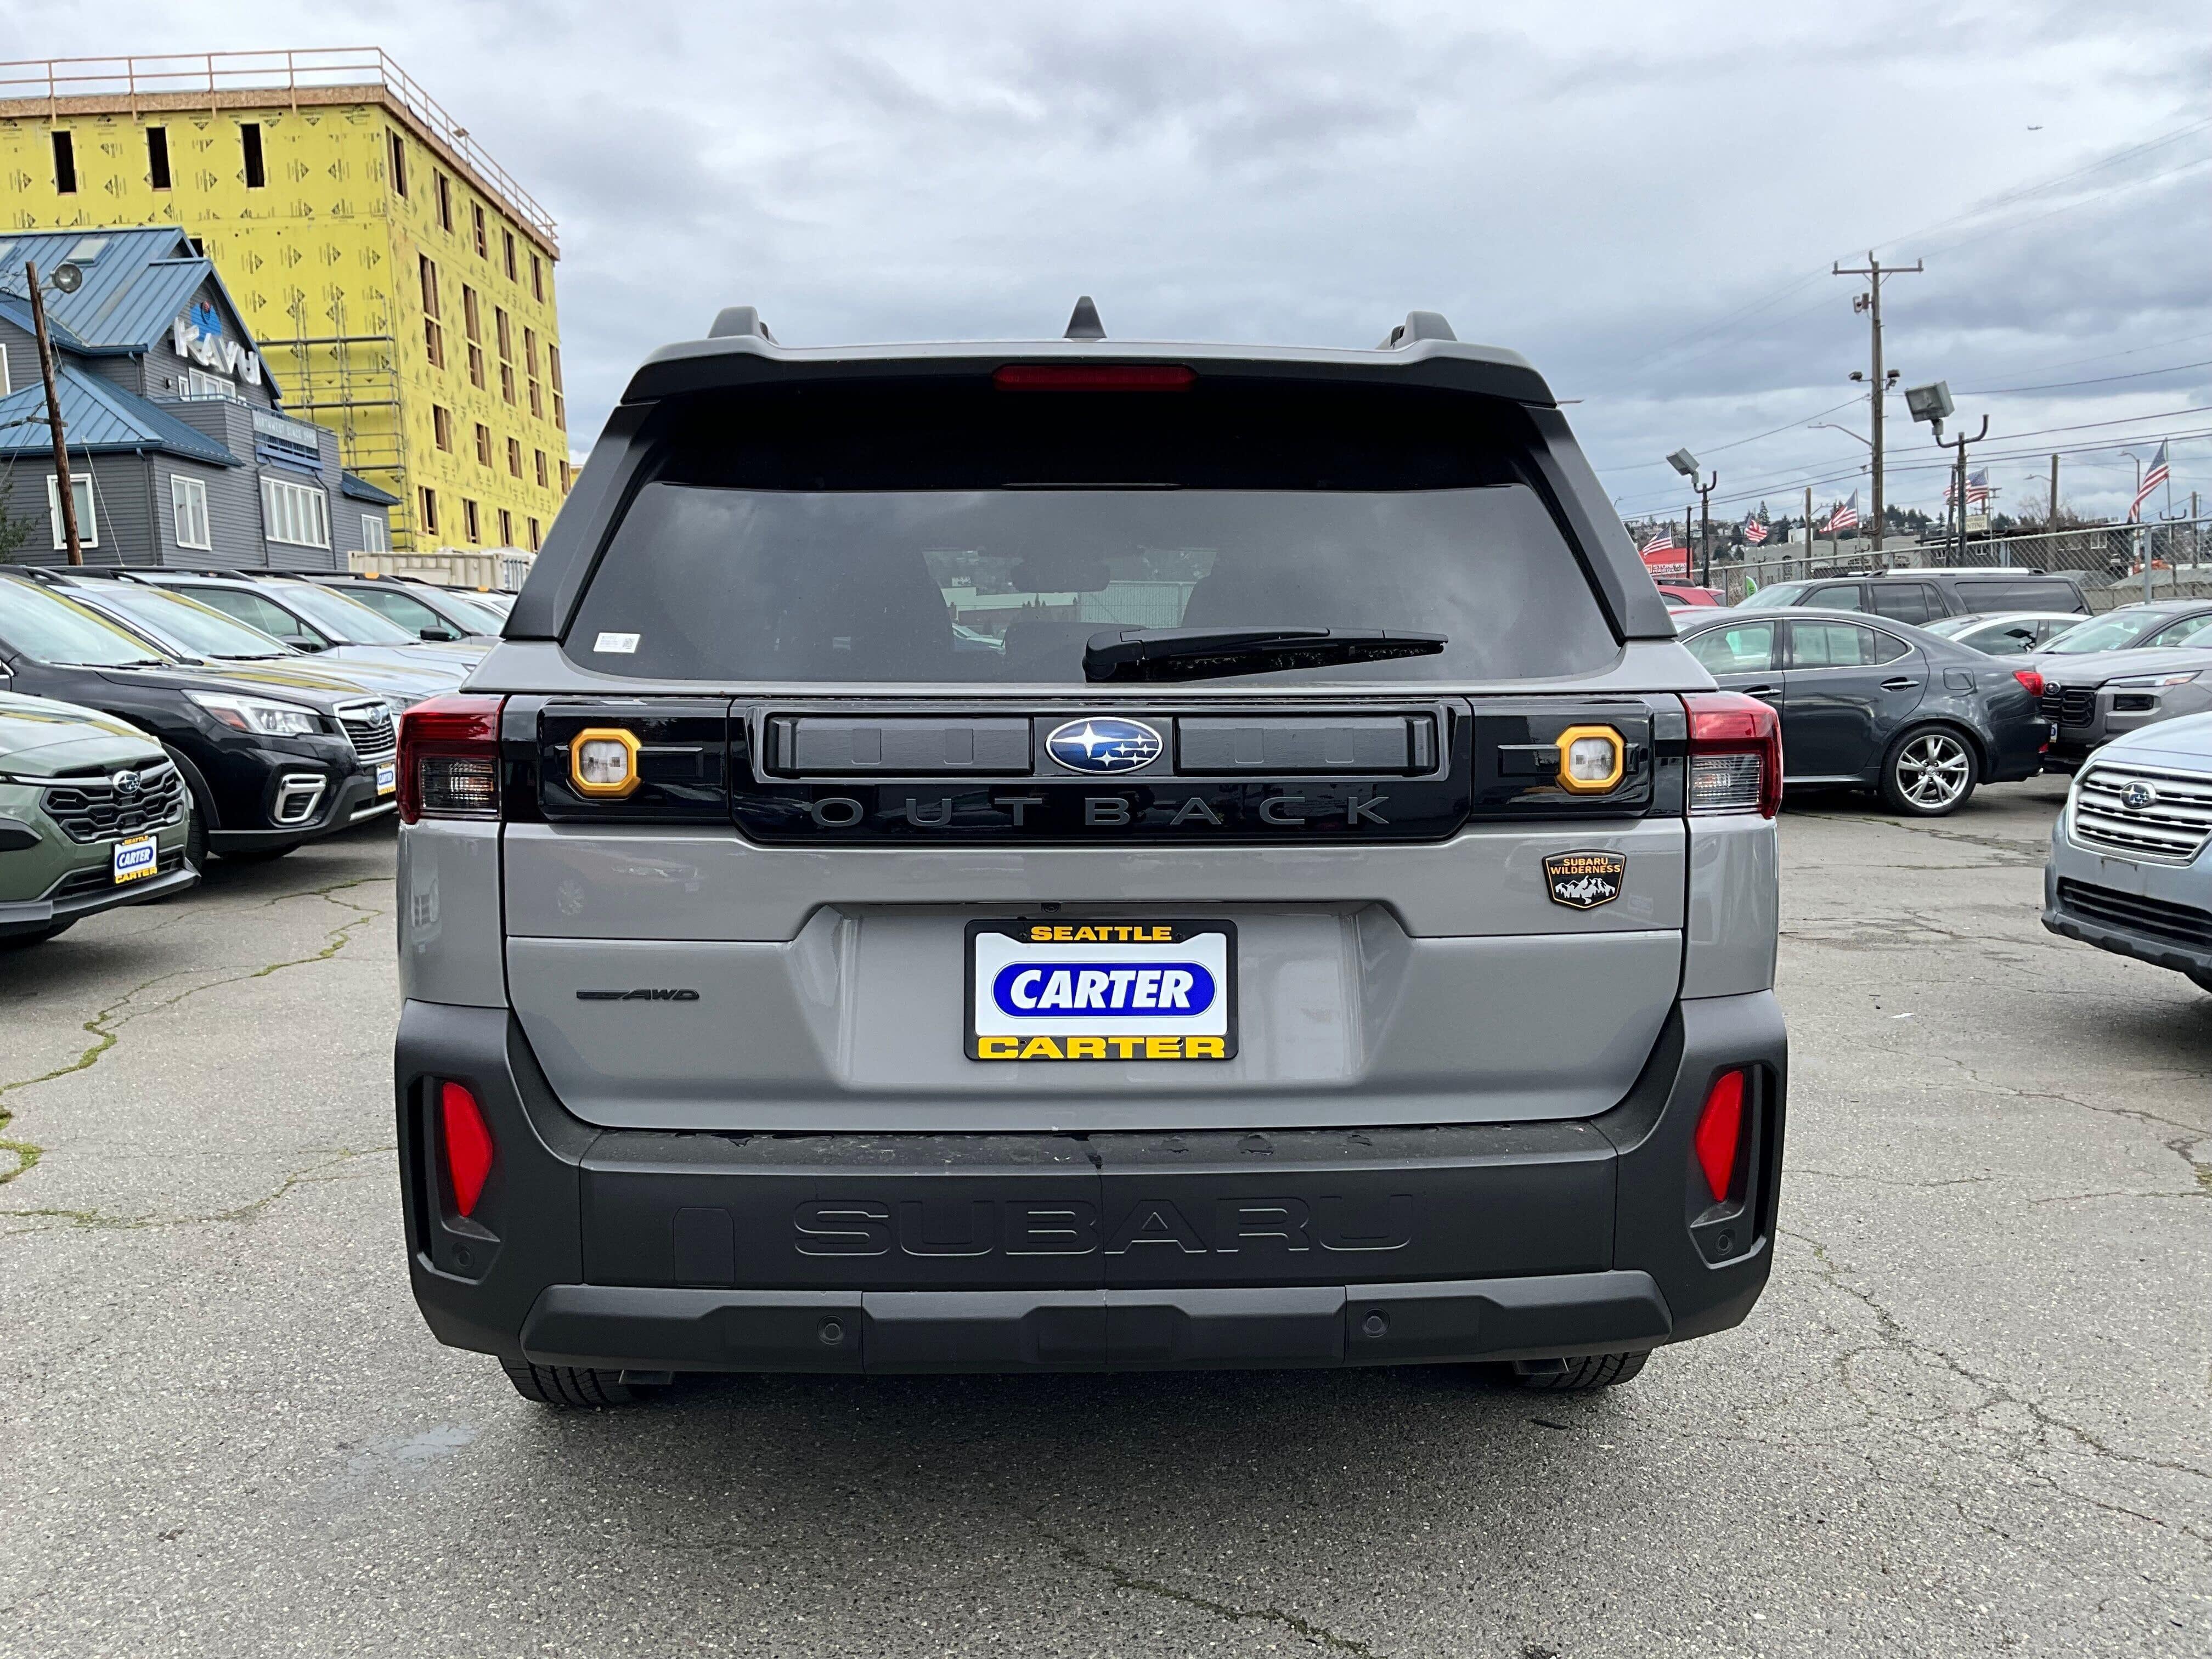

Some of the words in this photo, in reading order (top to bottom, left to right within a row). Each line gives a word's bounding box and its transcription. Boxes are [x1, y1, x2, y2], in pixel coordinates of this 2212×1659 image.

[174, 317, 261, 385] KAVU
[255, 416, 284, 435] NORTHWEST
[286, 425, 302, 439] SINCE
[811, 797, 1389, 826] OUTBACK
[124, 835, 149, 845] SEATTLE
[119, 848, 150, 867] CARTER
[1564, 857, 1608, 866] SUBARU
[115, 867, 157, 884] CARTER
[1550, 865, 1621, 875] WILDERNESS
[1031, 926, 1172, 941] SEATTLE
[622, 989, 699, 1000] AWD
[1011, 969, 1194, 1009] CARTER
[978, 1037, 1225, 1058] CARTER
[794, 1194, 1413, 1256] SUBARU
